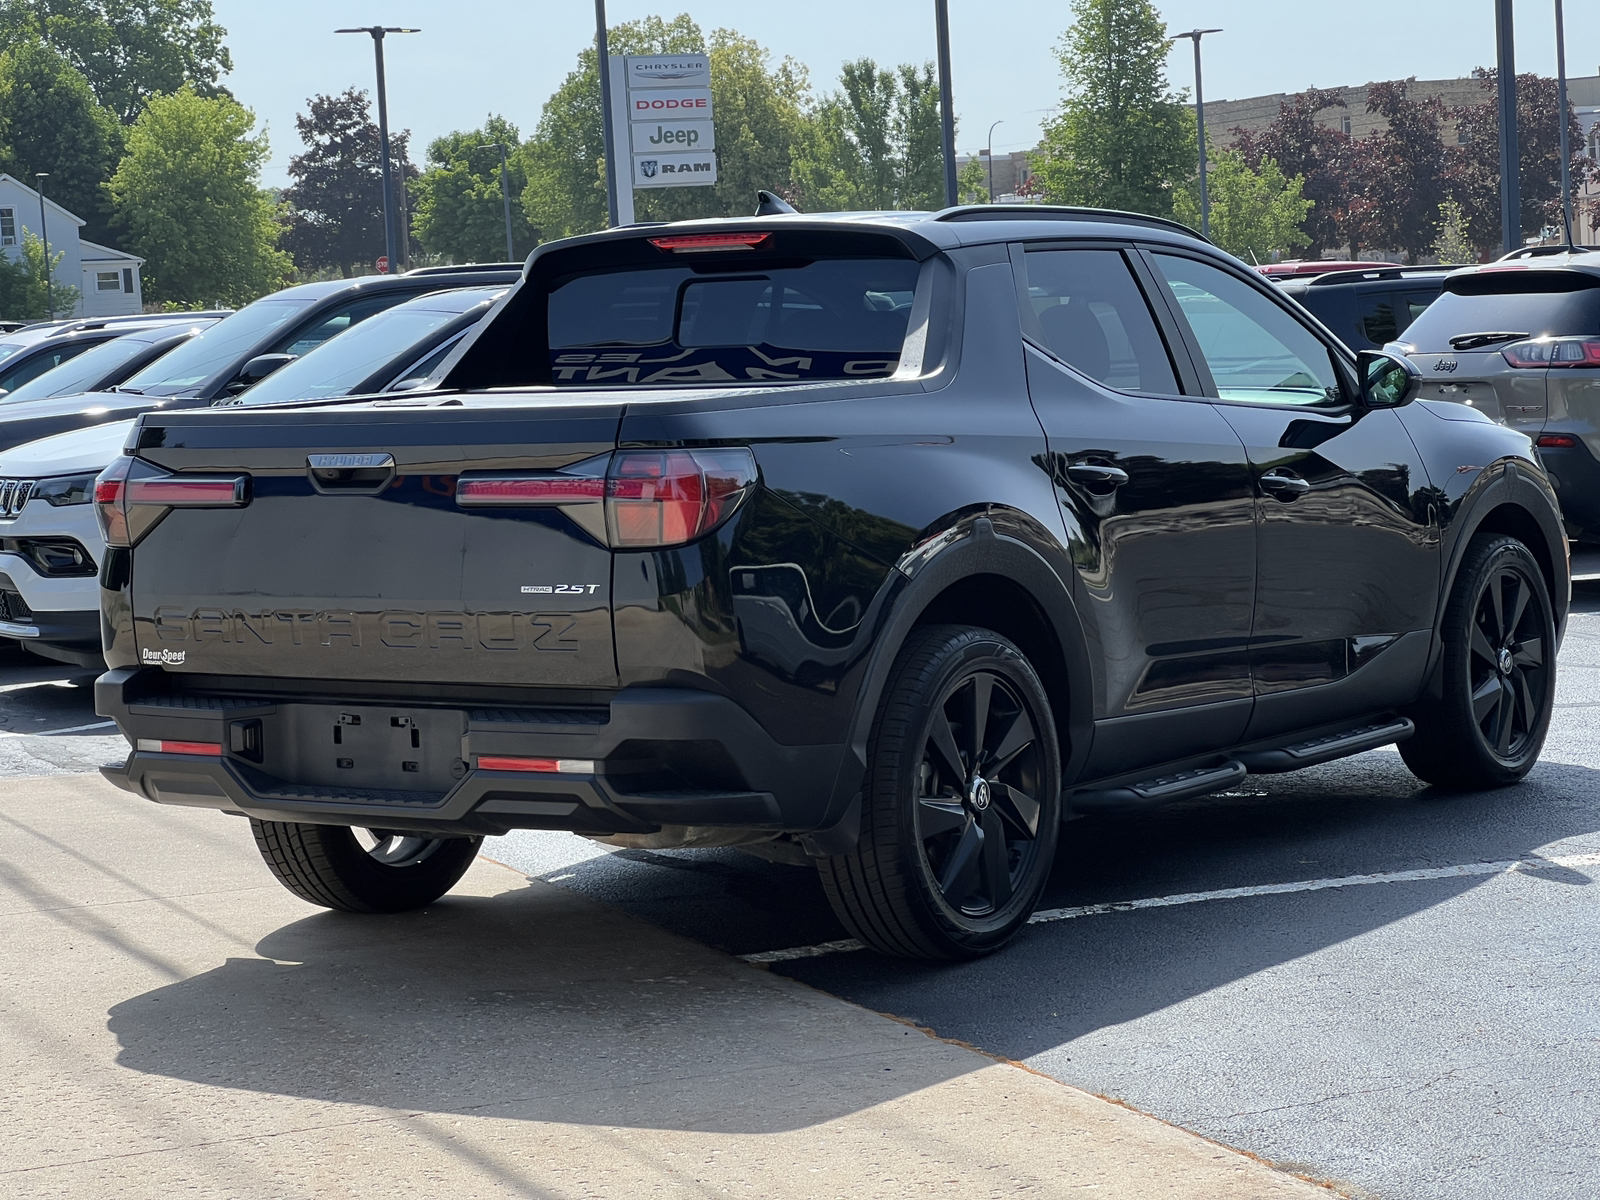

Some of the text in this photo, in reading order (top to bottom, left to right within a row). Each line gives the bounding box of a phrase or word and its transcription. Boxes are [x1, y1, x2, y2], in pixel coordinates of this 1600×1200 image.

[635, 62, 703, 70] CHRYSLER
[636, 98, 707, 110] DODGE
[649, 126, 699, 146] Jeep
[661, 162, 711, 174] RAM
[1433, 358, 1458, 373] Jeep
[318, 455, 374, 466] HYUNDAI
[154, 606, 581, 652] SANTA CRUZ
[142, 647, 186, 662] Deur Speet
